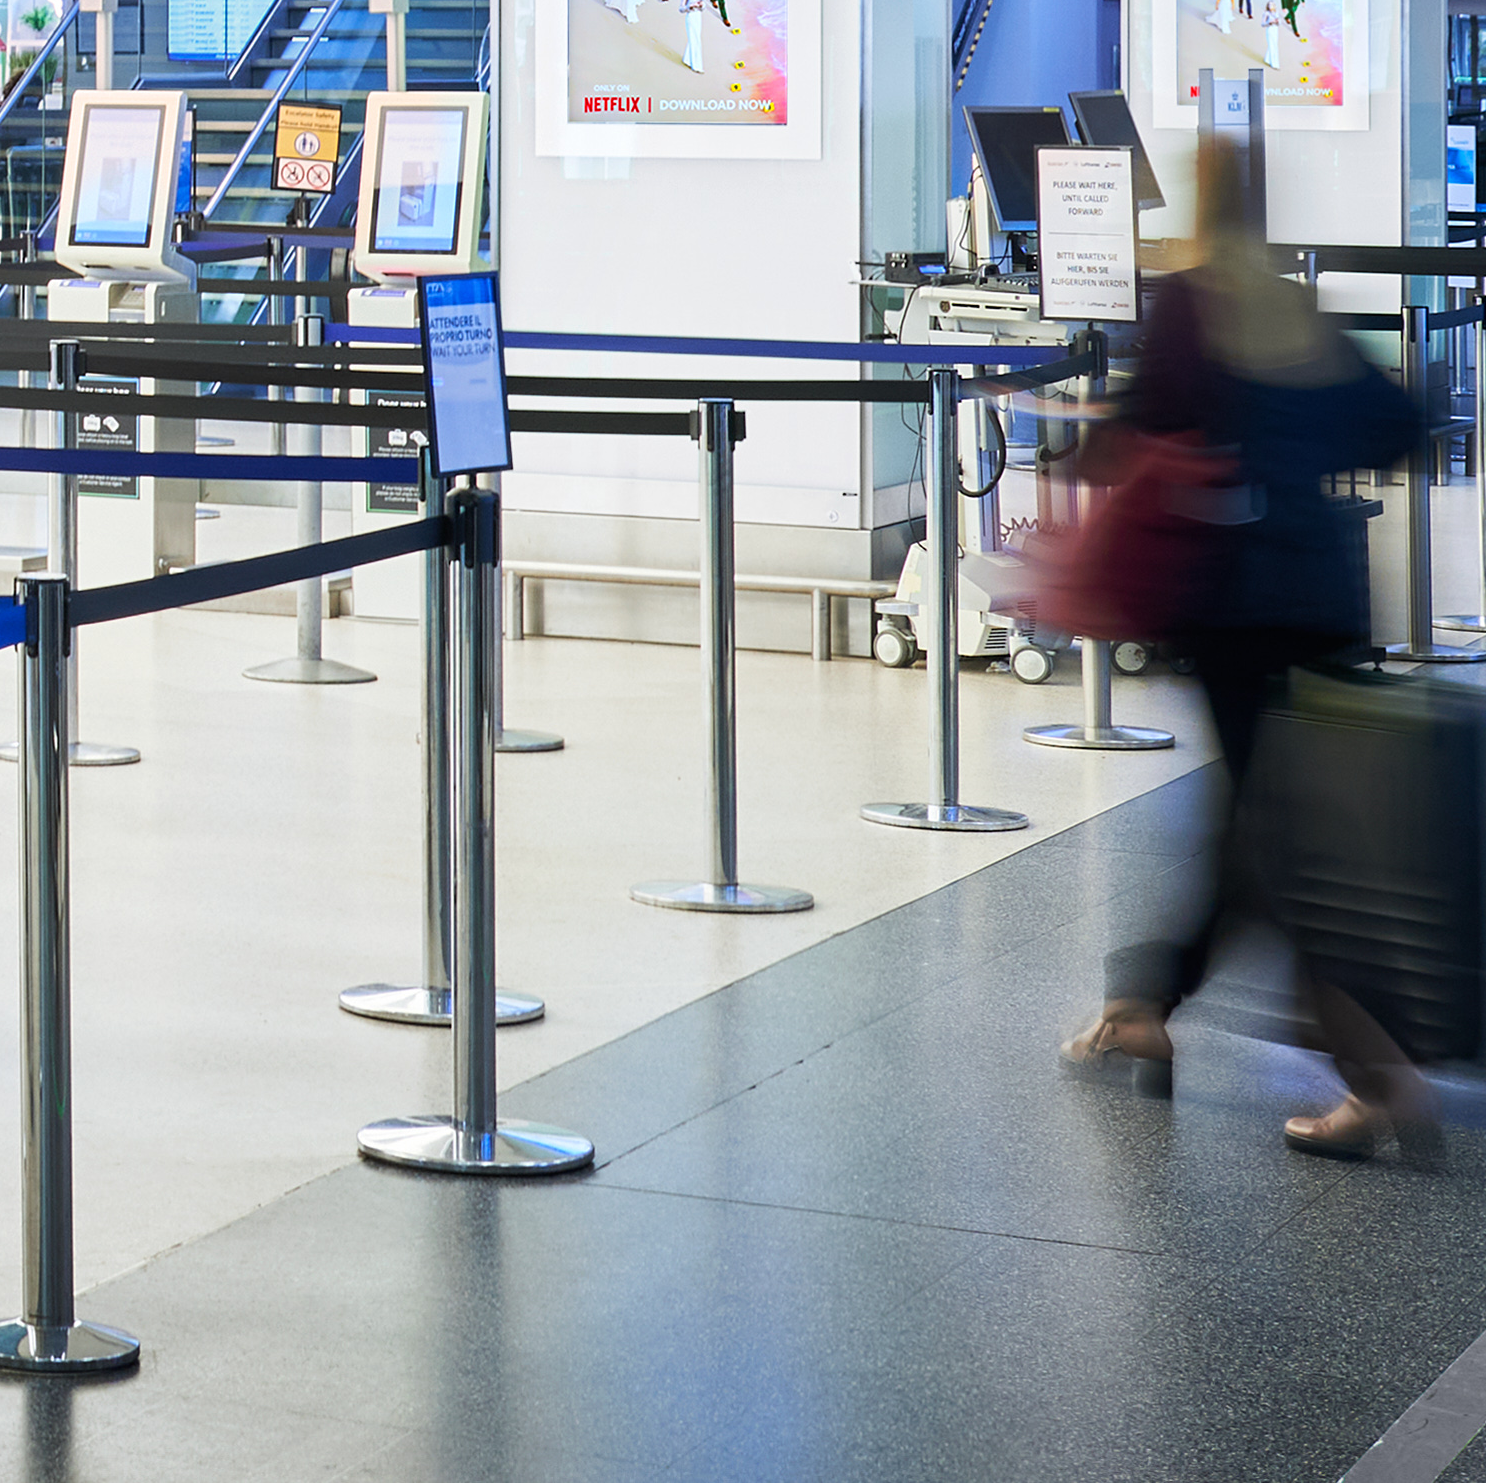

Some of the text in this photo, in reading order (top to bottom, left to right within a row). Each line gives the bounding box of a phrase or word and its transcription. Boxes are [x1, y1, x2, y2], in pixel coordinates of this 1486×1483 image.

[593, 84, 630, 93] ONLY ON
[1265, 87, 1331, 97] WNLOAD NOW
[584, 96, 772, 113] NETFLIX DOWNLOAD NOW
[1053, 181, 1118, 191] PLEASE WAIT HERE,
[1062, 194, 1109, 203] UNTIL CALLED
[1068, 207, 1104, 216] FORWARD
[1056, 252, 1118, 262] BITTE WARTEN SIE
[1067, 265, 1109, 274] HIER, BIS SIE
[1051, 278, 1129, 288] AUFGERUFEN WERDEN
[430, 315, 482, 330] ATTENDERE IL
[430, 327, 493, 343] PROPRIO TURNO
[432, 342, 496, 358] WAIT YOUR TURN
